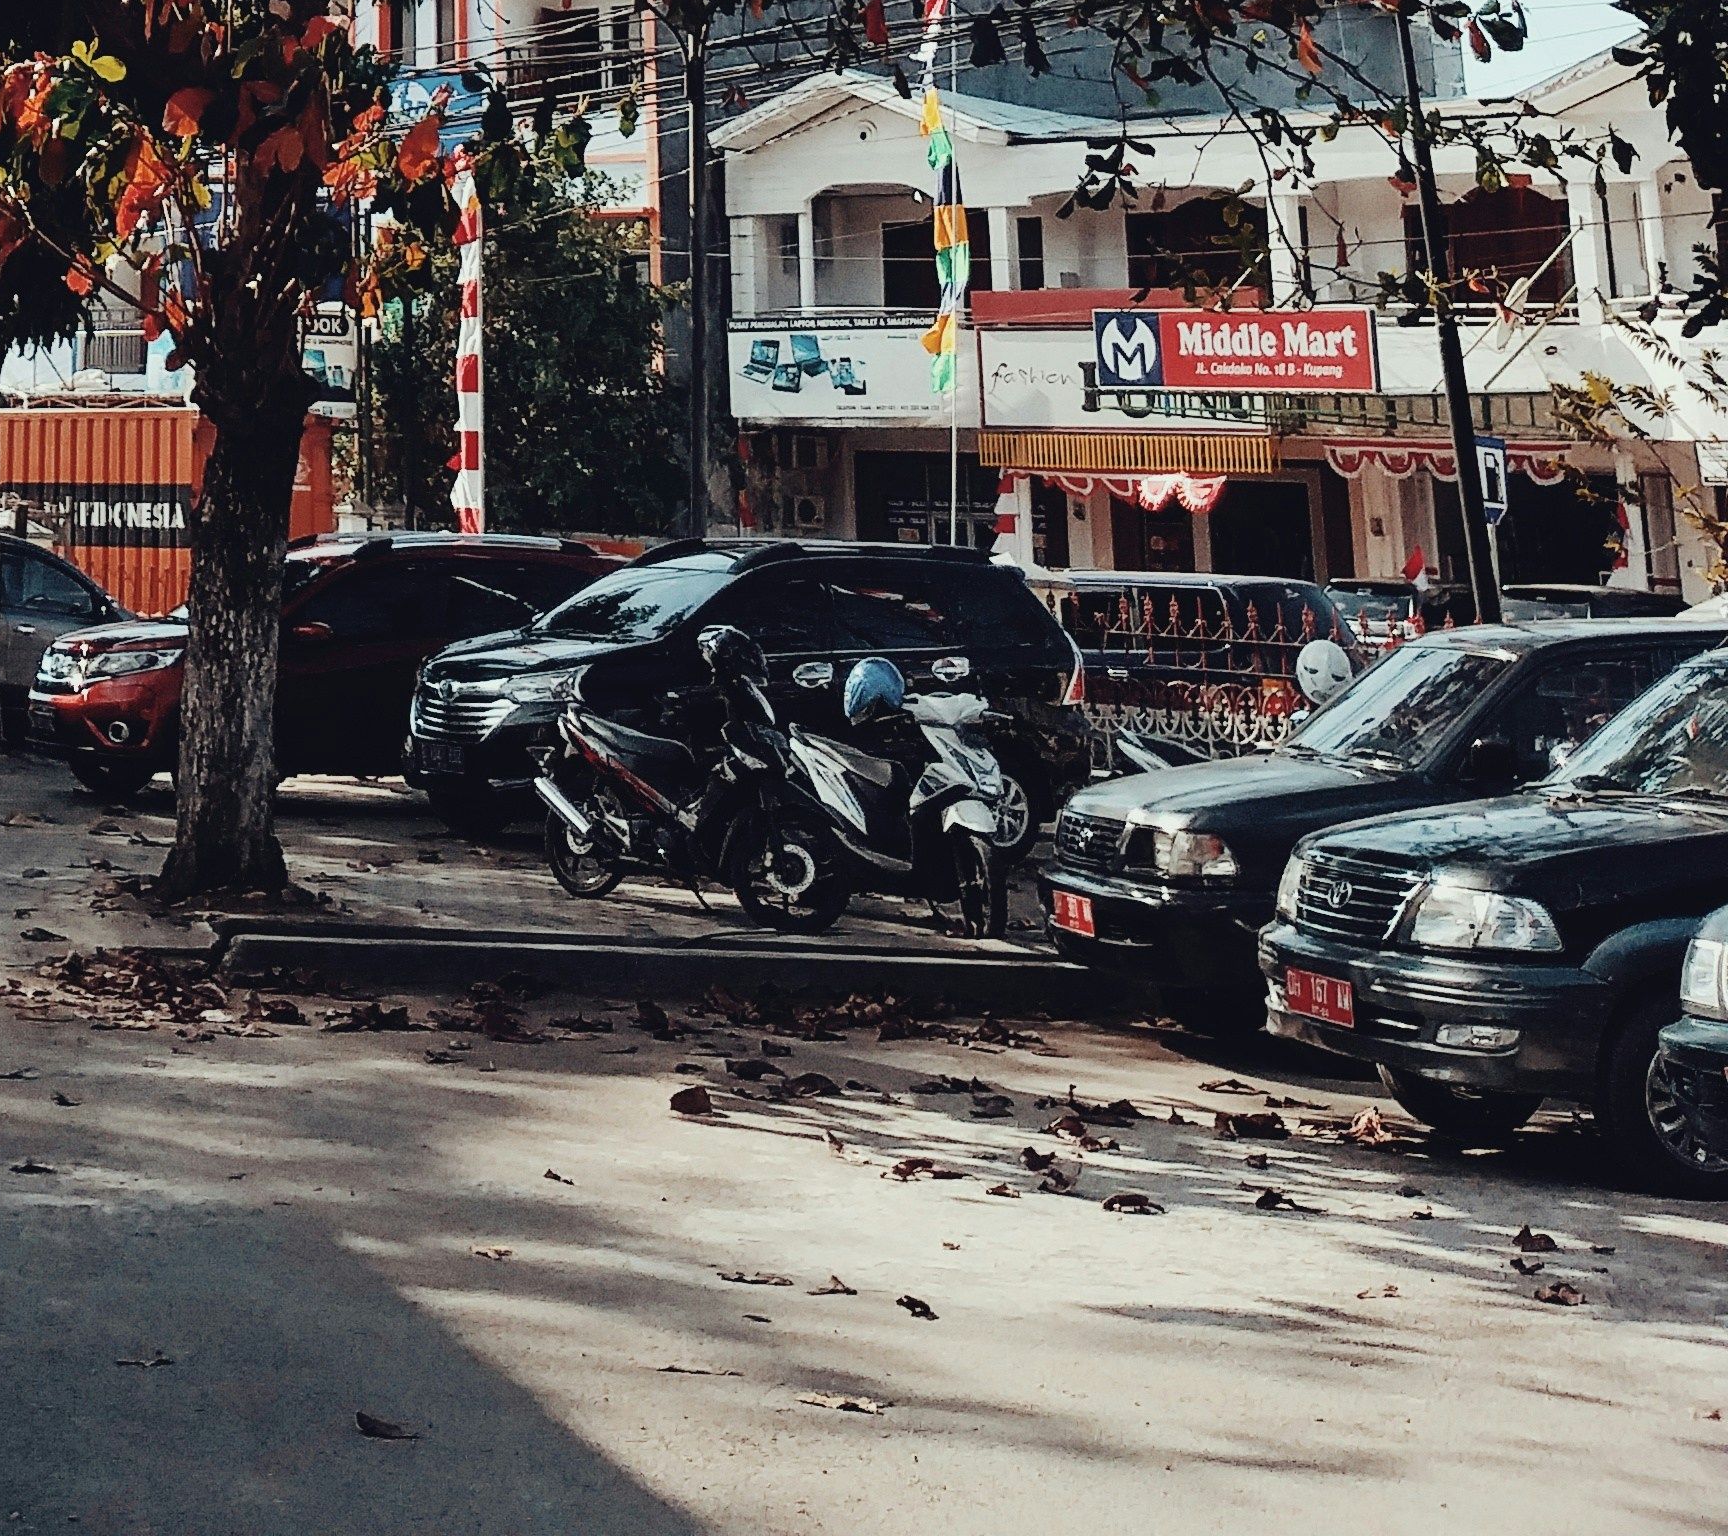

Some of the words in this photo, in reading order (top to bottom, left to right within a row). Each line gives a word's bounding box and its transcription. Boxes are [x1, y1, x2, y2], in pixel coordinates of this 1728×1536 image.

[1176, 321, 1277, 357] Middle
[1281, 321, 1358, 358] Mart
[1254, 362, 1272, 376] No.
[1303, 362, 1343, 378] Kupang
[1311, 977, 1328, 1004] 167
